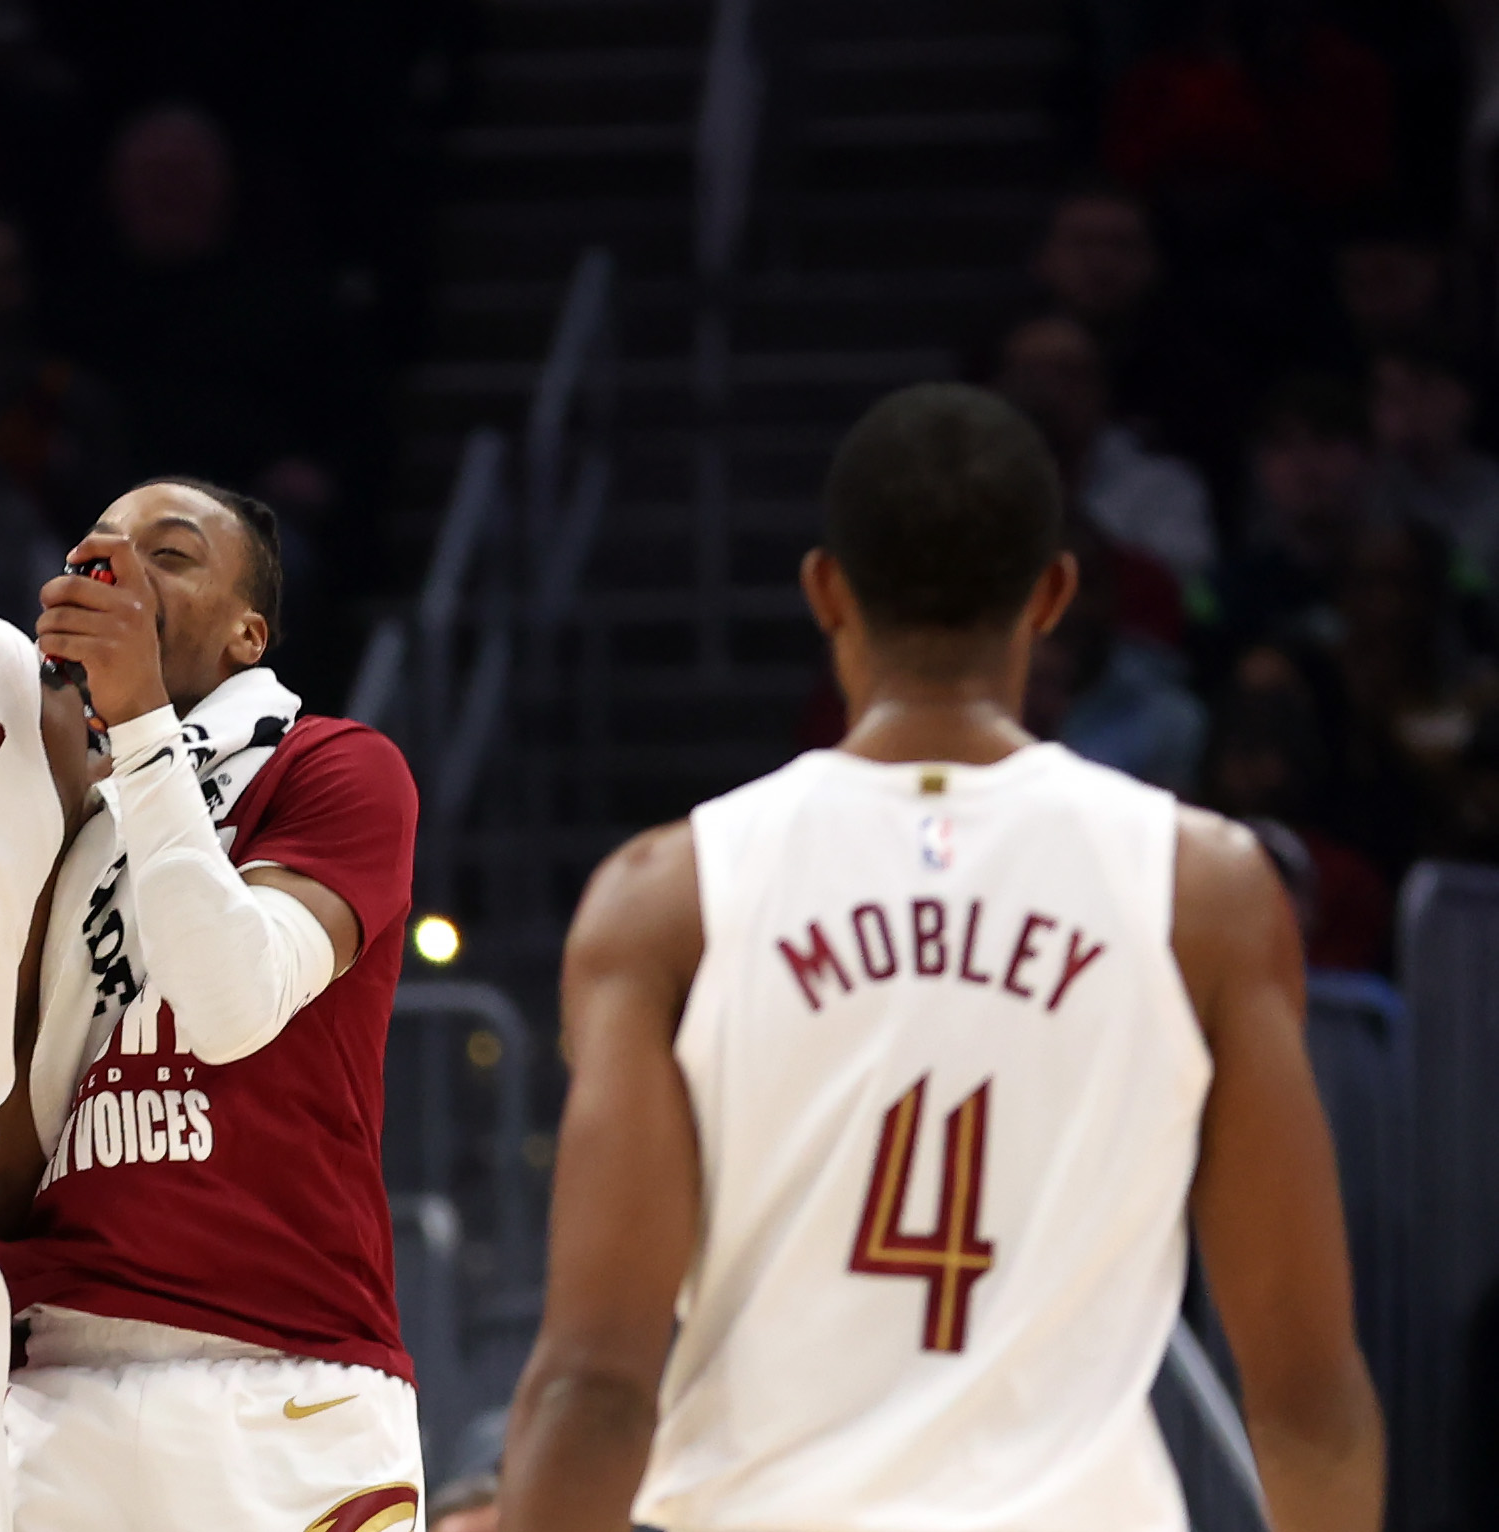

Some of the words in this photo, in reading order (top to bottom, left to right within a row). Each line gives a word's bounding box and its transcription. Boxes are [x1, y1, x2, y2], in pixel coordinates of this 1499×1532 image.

[776, 897, 1107, 1014] MOBLEY
[157, 1066, 196, 1083] BY
[75, 1088, 214, 1172] VOICES
[846, 1067, 996, 1354] 4
